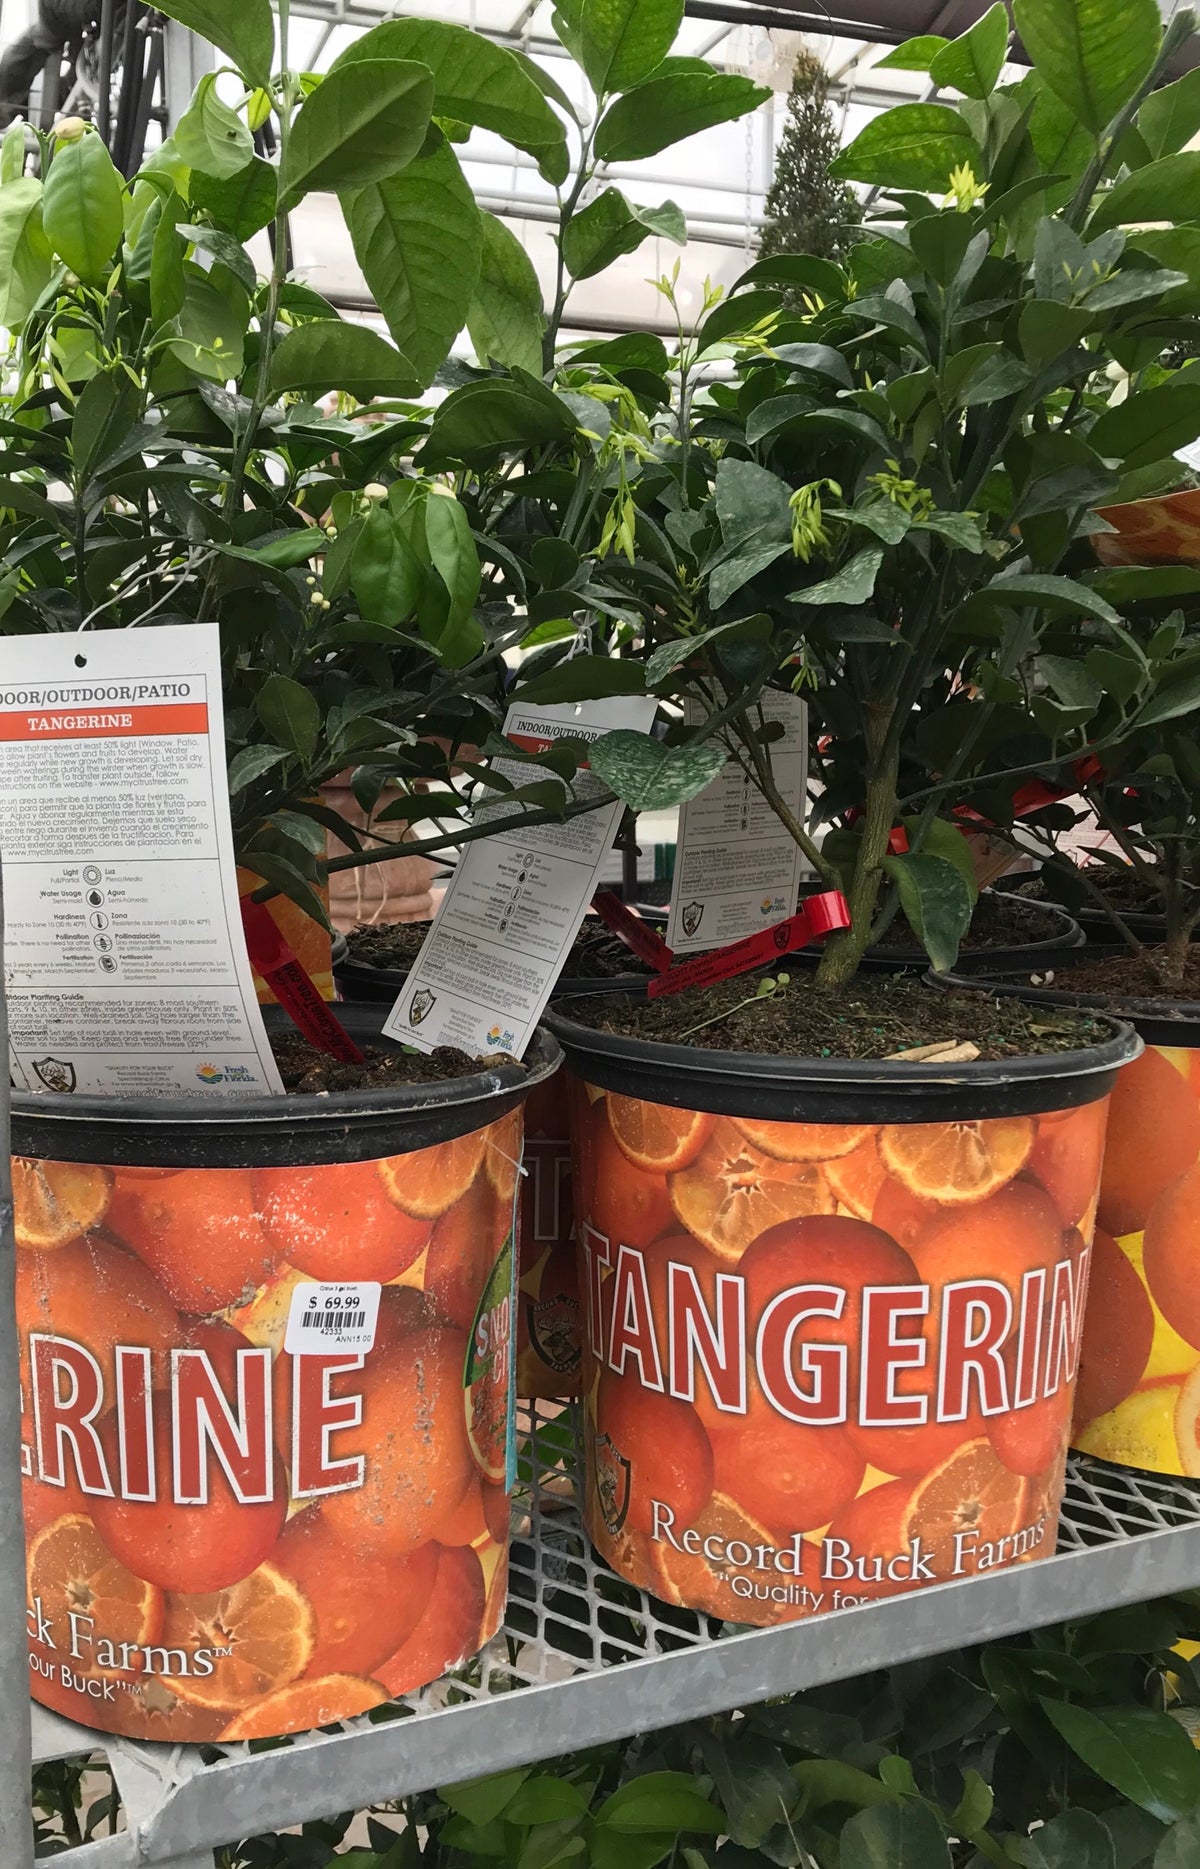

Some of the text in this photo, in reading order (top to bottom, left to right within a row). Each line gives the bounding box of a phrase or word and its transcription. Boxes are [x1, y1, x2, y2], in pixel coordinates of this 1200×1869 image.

[27, 714, 133, 731] TANGERINE
[41, 743, 72, 751] receives
[103, 741, 118, 749] 50%
[120, 740, 136, 750] light
[6, 760, 37, 769] regularly
[78, 758, 105, 766] growth
[189, 754, 202, 762] dry
[23, 767, 59, 775] waterings
[60, 766, 84, 774] during
[126, 763, 148, 771] when
[149, 762, 177, 771] growth
[13, 774, 31, 782] after
[72, 772, 100, 780] transfer
[101, 771, 122, 780] plant
[155, 770, 179, 778] follow
[64, 780, 92, 788] website
[99, 777, 188, 787] www.mycitrustree.com
[38, 797, 54, 805] que
[55, 795, 80, 803] recibe
[119, 793, 134, 801] 50%
[135, 793, 145, 801] luz
[39, 804, 67, 812] permitir
[95, 802, 121, 811] planta
[122, 801, 133, 809] de
[163, 800, 185, 808] frutas
[186, 800, 206, 809] para
[10, 813, 30, 821] Agua
[67, 810, 120, 819] regularmente
[121, 808, 154, 816] mientras
[18, 819, 25, 827] el
[102, 817, 136, 825] Dejemos
[137, 817, 153, 825] que
[25, 826, 45, 835] riego
[79, 825, 86, 833] el
[119, 824, 151, 832] cuando
[152, 823, 160, 831] el
[161, 822, 208, 830] crecimiento
[41, 833, 64, 841] forma
[65, 833, 97, 841] despues
[99, 832, 110, 840] de
[1, 842, 26, 850] planta
[57, 841, 72, 850] siga
[73, 840, 123, 848] instrucciones
[137, 838, 180, 847] plantacion
[193, 837, 201, 845] el
[8, 848, 94, 857] www.mycitrustree.com
[63, 869, 78, 877] Light
[61, 890, 82, 898] Usage
[107, 889, 125, 897] Agua
[224, 1065, 248, 1074] Fresh
[308, 1296, 360, 1309] $ 69.99
[20, 1333, 365, 1504] RINE
[650, 1499, 805, 1577] Record
[820, 1536, 936, 1583] Buck
